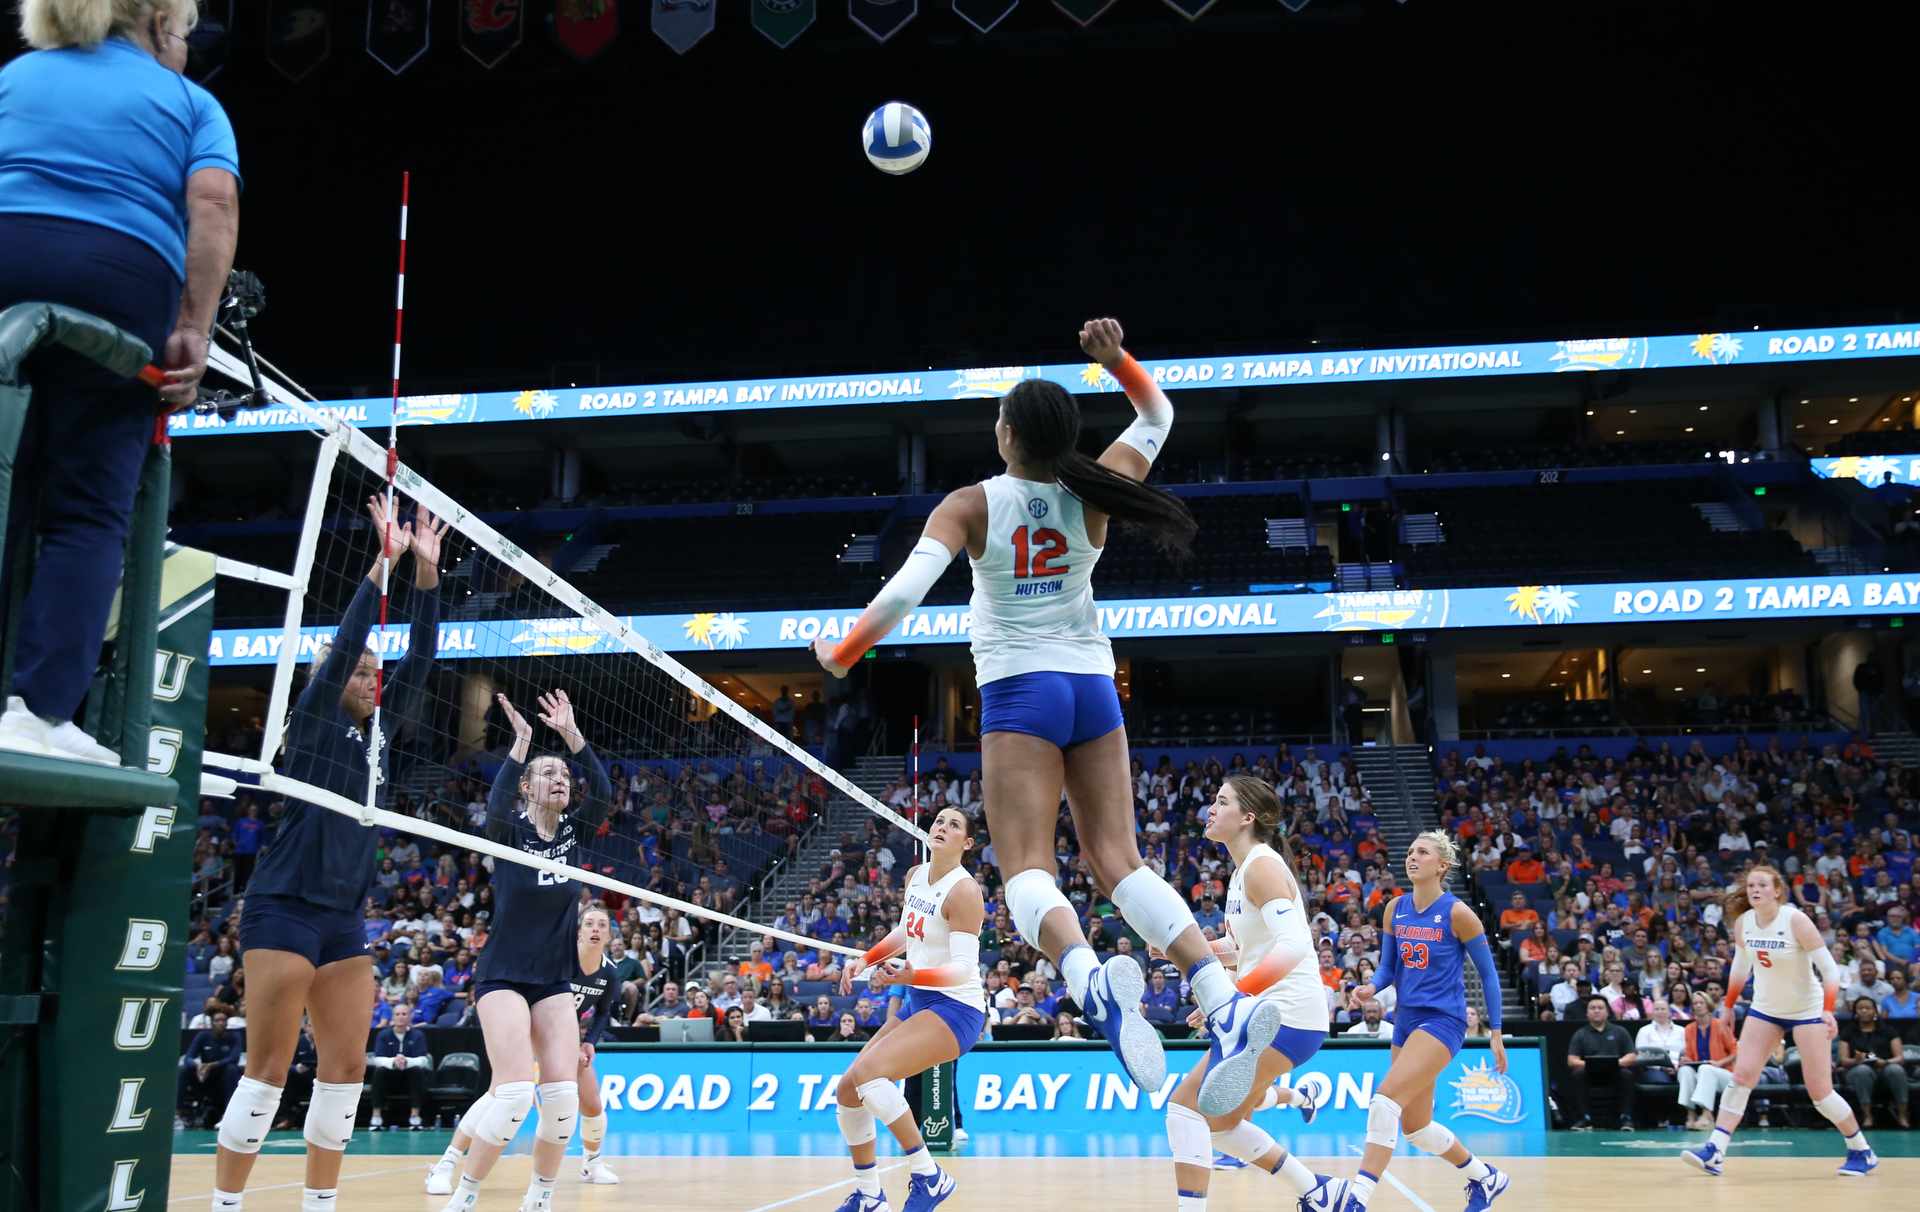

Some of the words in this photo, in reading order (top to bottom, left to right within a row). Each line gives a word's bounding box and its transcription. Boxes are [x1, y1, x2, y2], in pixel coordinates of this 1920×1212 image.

[1769, 335, 1835, 355] ROAD
[1843, 334, 1857, 351] 2
[1151, 365, 1214, 384] ROAD
[1221, 363, 1236, 380] 2
[1242, 360, 1313, 380] TAMPA
[1320, 357, 1364, 376] BAY
[1369, 350, 1523, 374] INVITATIONAL
[579, 393, 637, 411] ROAD
[643, 391, 657, 408] 2
[663, 387, 729, 406] TAMPA
[735, 385, 776, 403] BAY
[780, 377, 924, 401] INVITATIONAL
[1540, 471, 1559, 484] 202
[1011, 525, 1071, 579] 12
[1015, 580, 1064, 596] HUTSON
[1613, 588, 1704, 615] ROAD
[1714, 586, 1735, 611] 2
[1745, 583, 1852, 610] TAMPA
[1863, 581, 1920, 607] BAY
[901, 613, 972, 636] TAMP
[1097, 603, 1277, 631] VITATIONAL
[233, 635, 284, 658] BAY
[907, 894, 937, 917] FLORIDA
[905, 911, 926, 943] 24
[1394, 924, 1443, 943] FLORIDA
[1401, 941, 1430, 970] 23
[1746, 939, 1786, 950] FLORIDA
[1756, 950, 1773, 969] 5
[602, 1073, 732, 1112] ROAD
[748, 1072, 779, 1111] 2
[974, 1073, 1071, 1111] BAY
